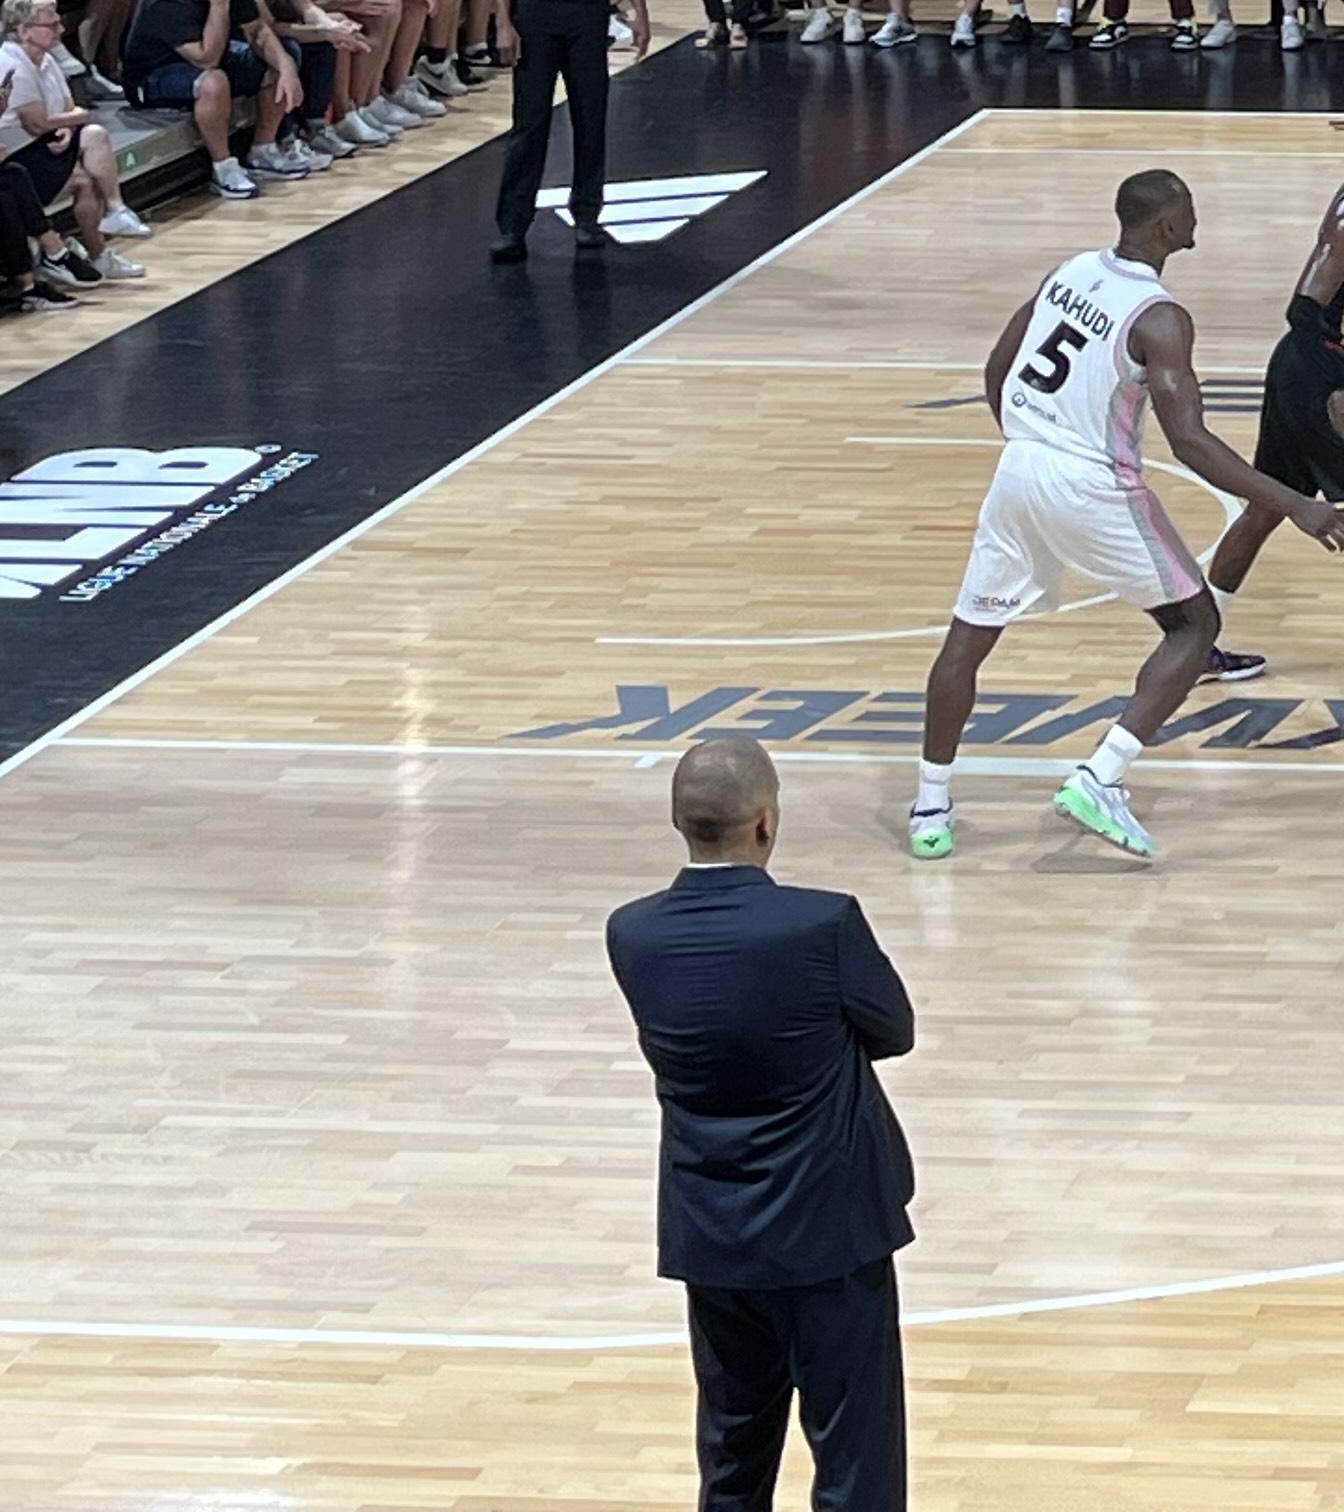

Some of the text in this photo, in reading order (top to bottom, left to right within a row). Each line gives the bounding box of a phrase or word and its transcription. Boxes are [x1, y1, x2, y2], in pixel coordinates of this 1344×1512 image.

[1045, 281, 1116, 342] KAHUDI
[1018, 320, 1090, 395] 5
[235, 451, 320, 493] BASKET
